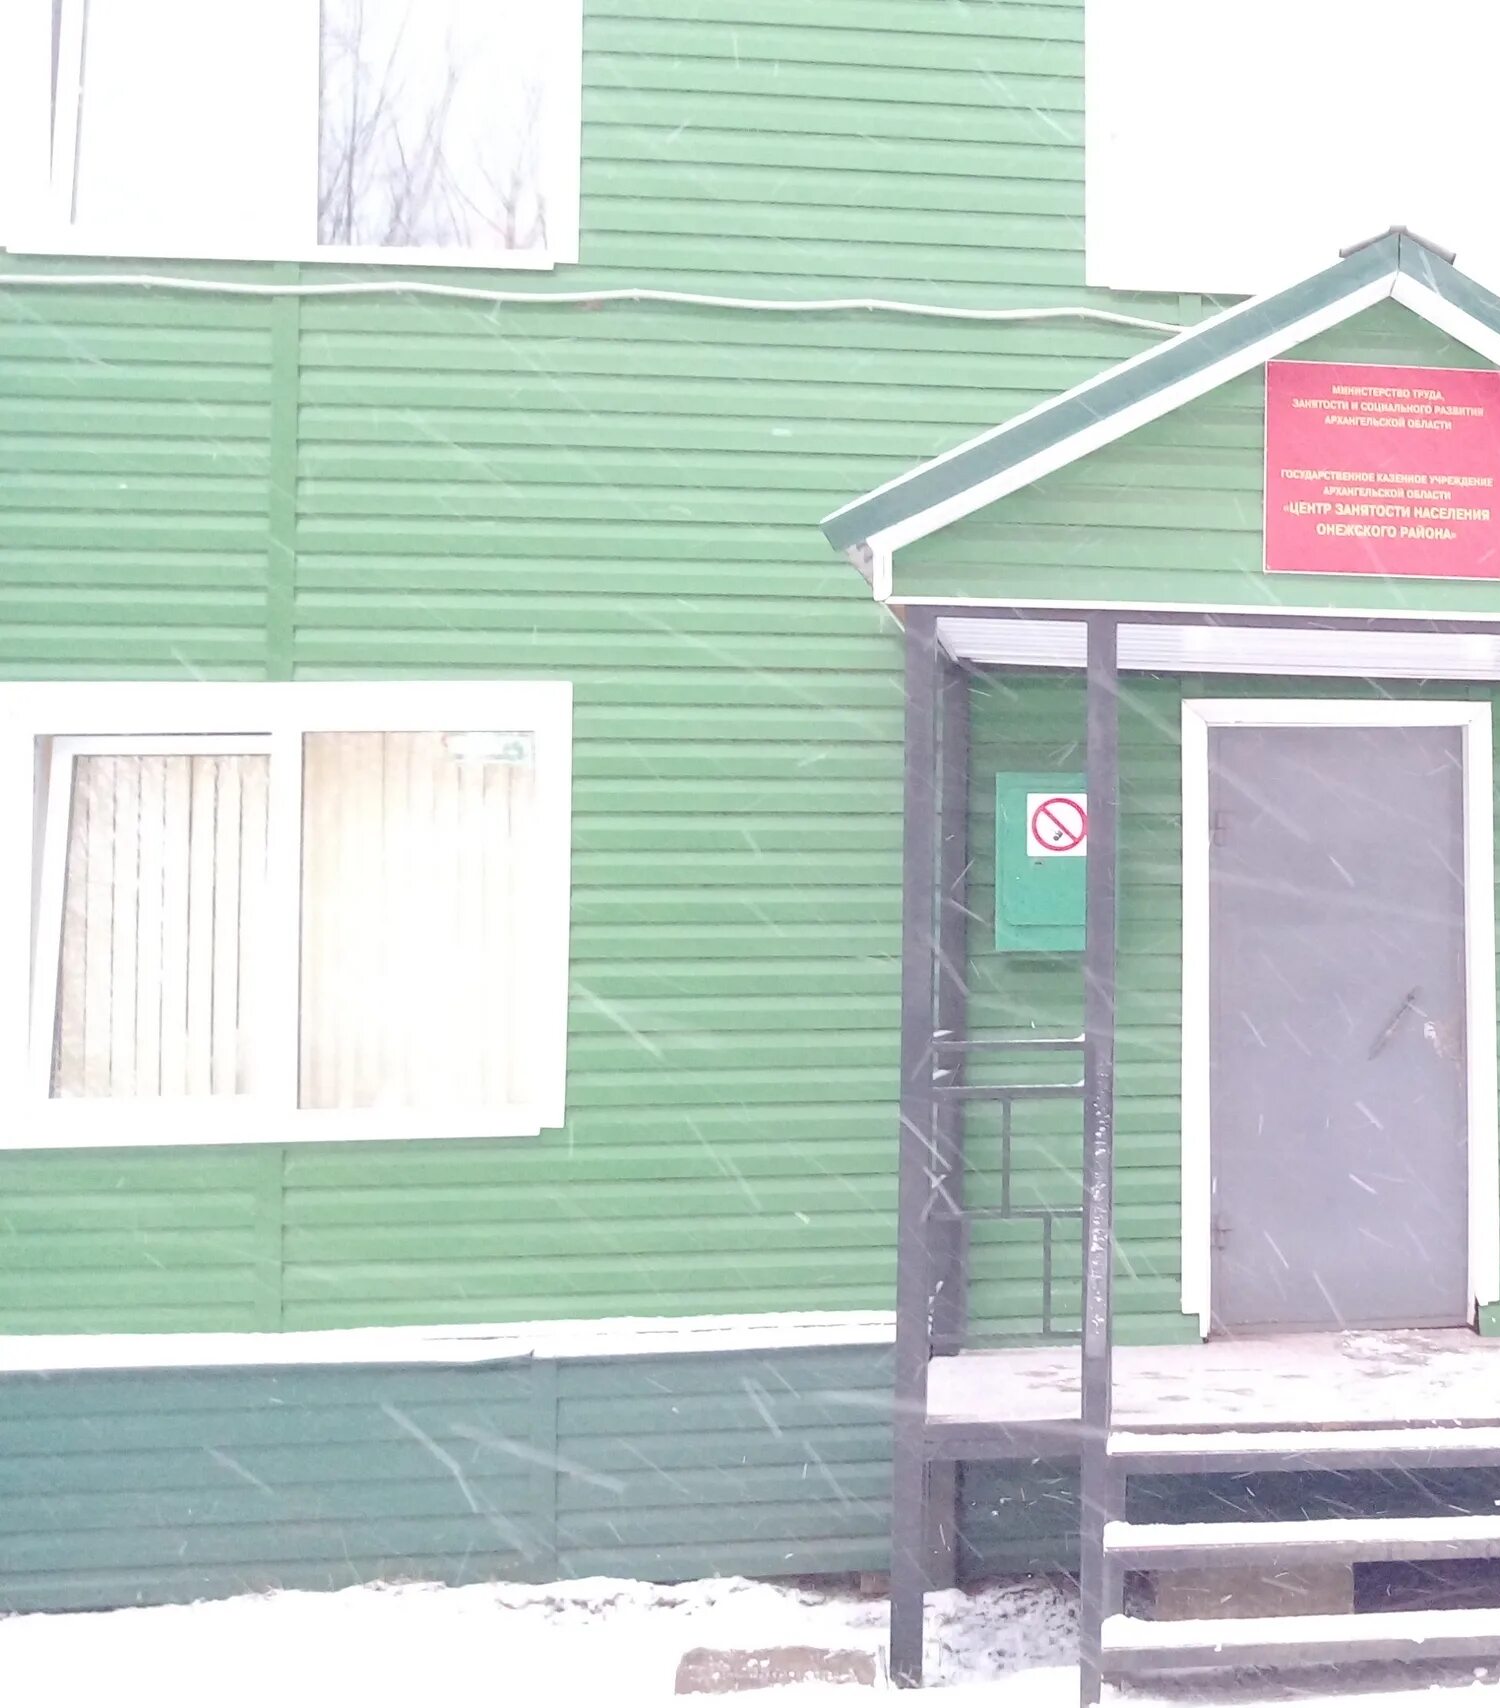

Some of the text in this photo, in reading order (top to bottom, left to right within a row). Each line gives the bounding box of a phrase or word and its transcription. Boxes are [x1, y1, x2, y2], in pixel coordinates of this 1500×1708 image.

[1332, 385, 1445, 401] МИНИСТЕРСТВО ТРУДА,
[1291, 398, 1484, 417] ЗАНЯТОСТИ И СОЦИАЛЬНОГО РАЗВИТИЯ
[1324, 415, 1452, 430] АРХАНГЕЛЬСКОЙ ОБЛАСТИ
[1281, 469, 1494, 487] ГОСУДАРСТВЕННОЕ КАЗЕННОЕ УЧРЕЖДЕНИЕ
[1323, 486, 1451, 500] АРХАНГЕЛЬСКОЙ ОБЛАСТИ
[1283, 501, 1490, 521] «ЦЕНТР ЗАНЯТОСТИ НАСЕЛЕНИЯ
[1316, 523, 1457, 540] ОНЕЖСКОГО РАЙОНА»
